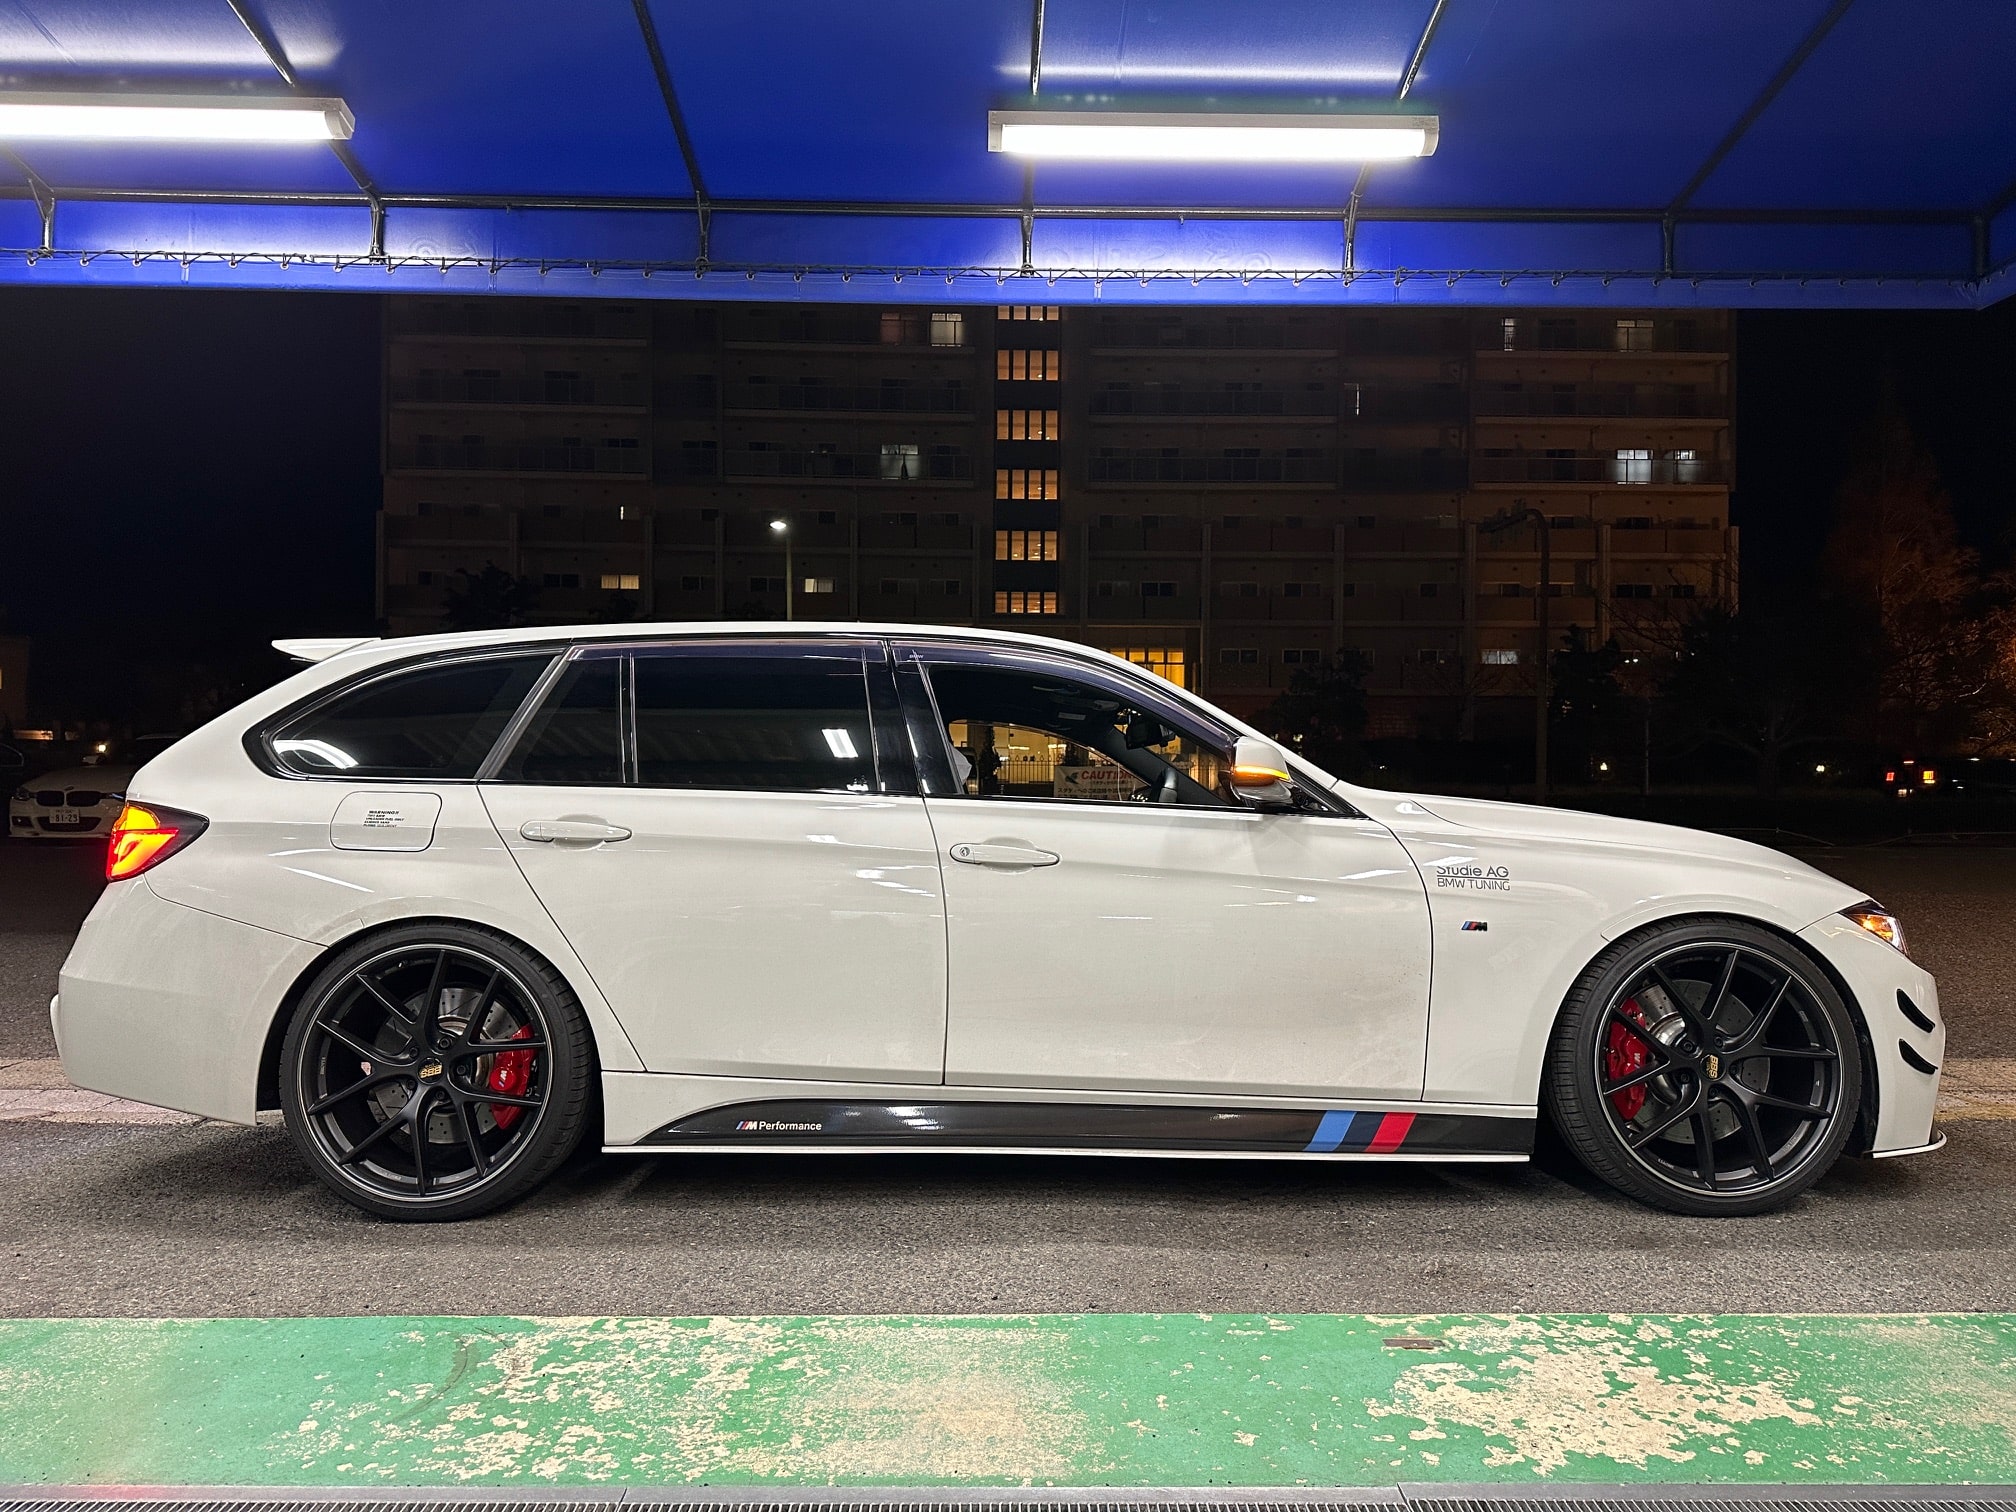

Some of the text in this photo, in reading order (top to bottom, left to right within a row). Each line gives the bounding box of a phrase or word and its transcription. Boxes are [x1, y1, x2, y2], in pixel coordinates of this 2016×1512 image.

[1436, 864, 1509, 878] Studie AG
[1437, 878, 1511, 891] BMW TUNING
[758, 1120, 822, 1131] Performance
